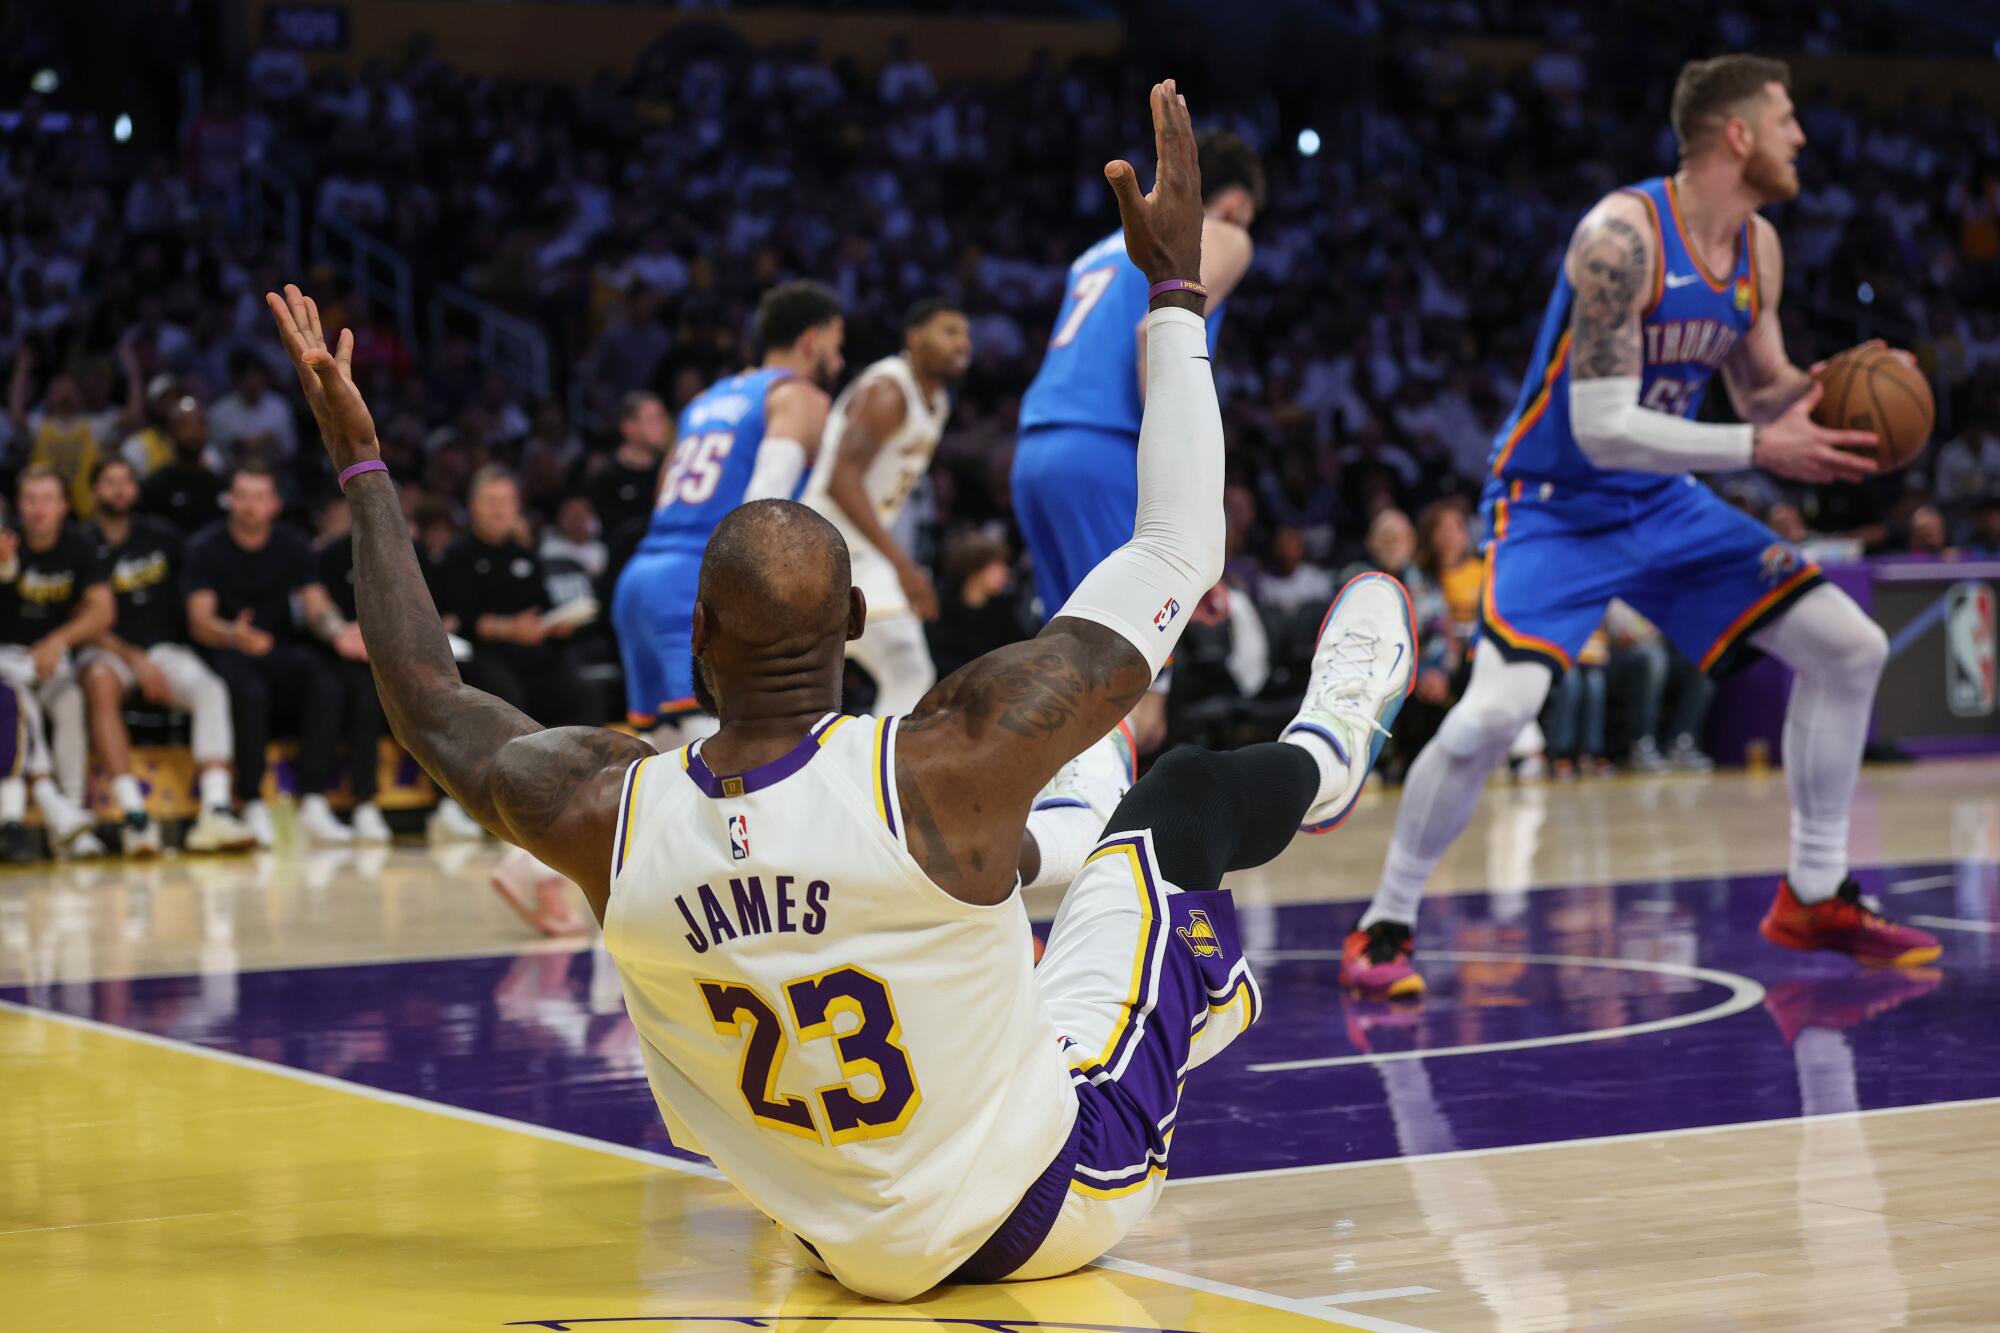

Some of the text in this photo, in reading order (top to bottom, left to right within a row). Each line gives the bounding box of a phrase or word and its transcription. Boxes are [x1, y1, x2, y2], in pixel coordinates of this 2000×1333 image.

[1051, 264, 1118, 348] 7
[655, 431, 736, 507] 25
[674, 875, 830, 954] JAMES
[693, 962, 923, 1147] 23
